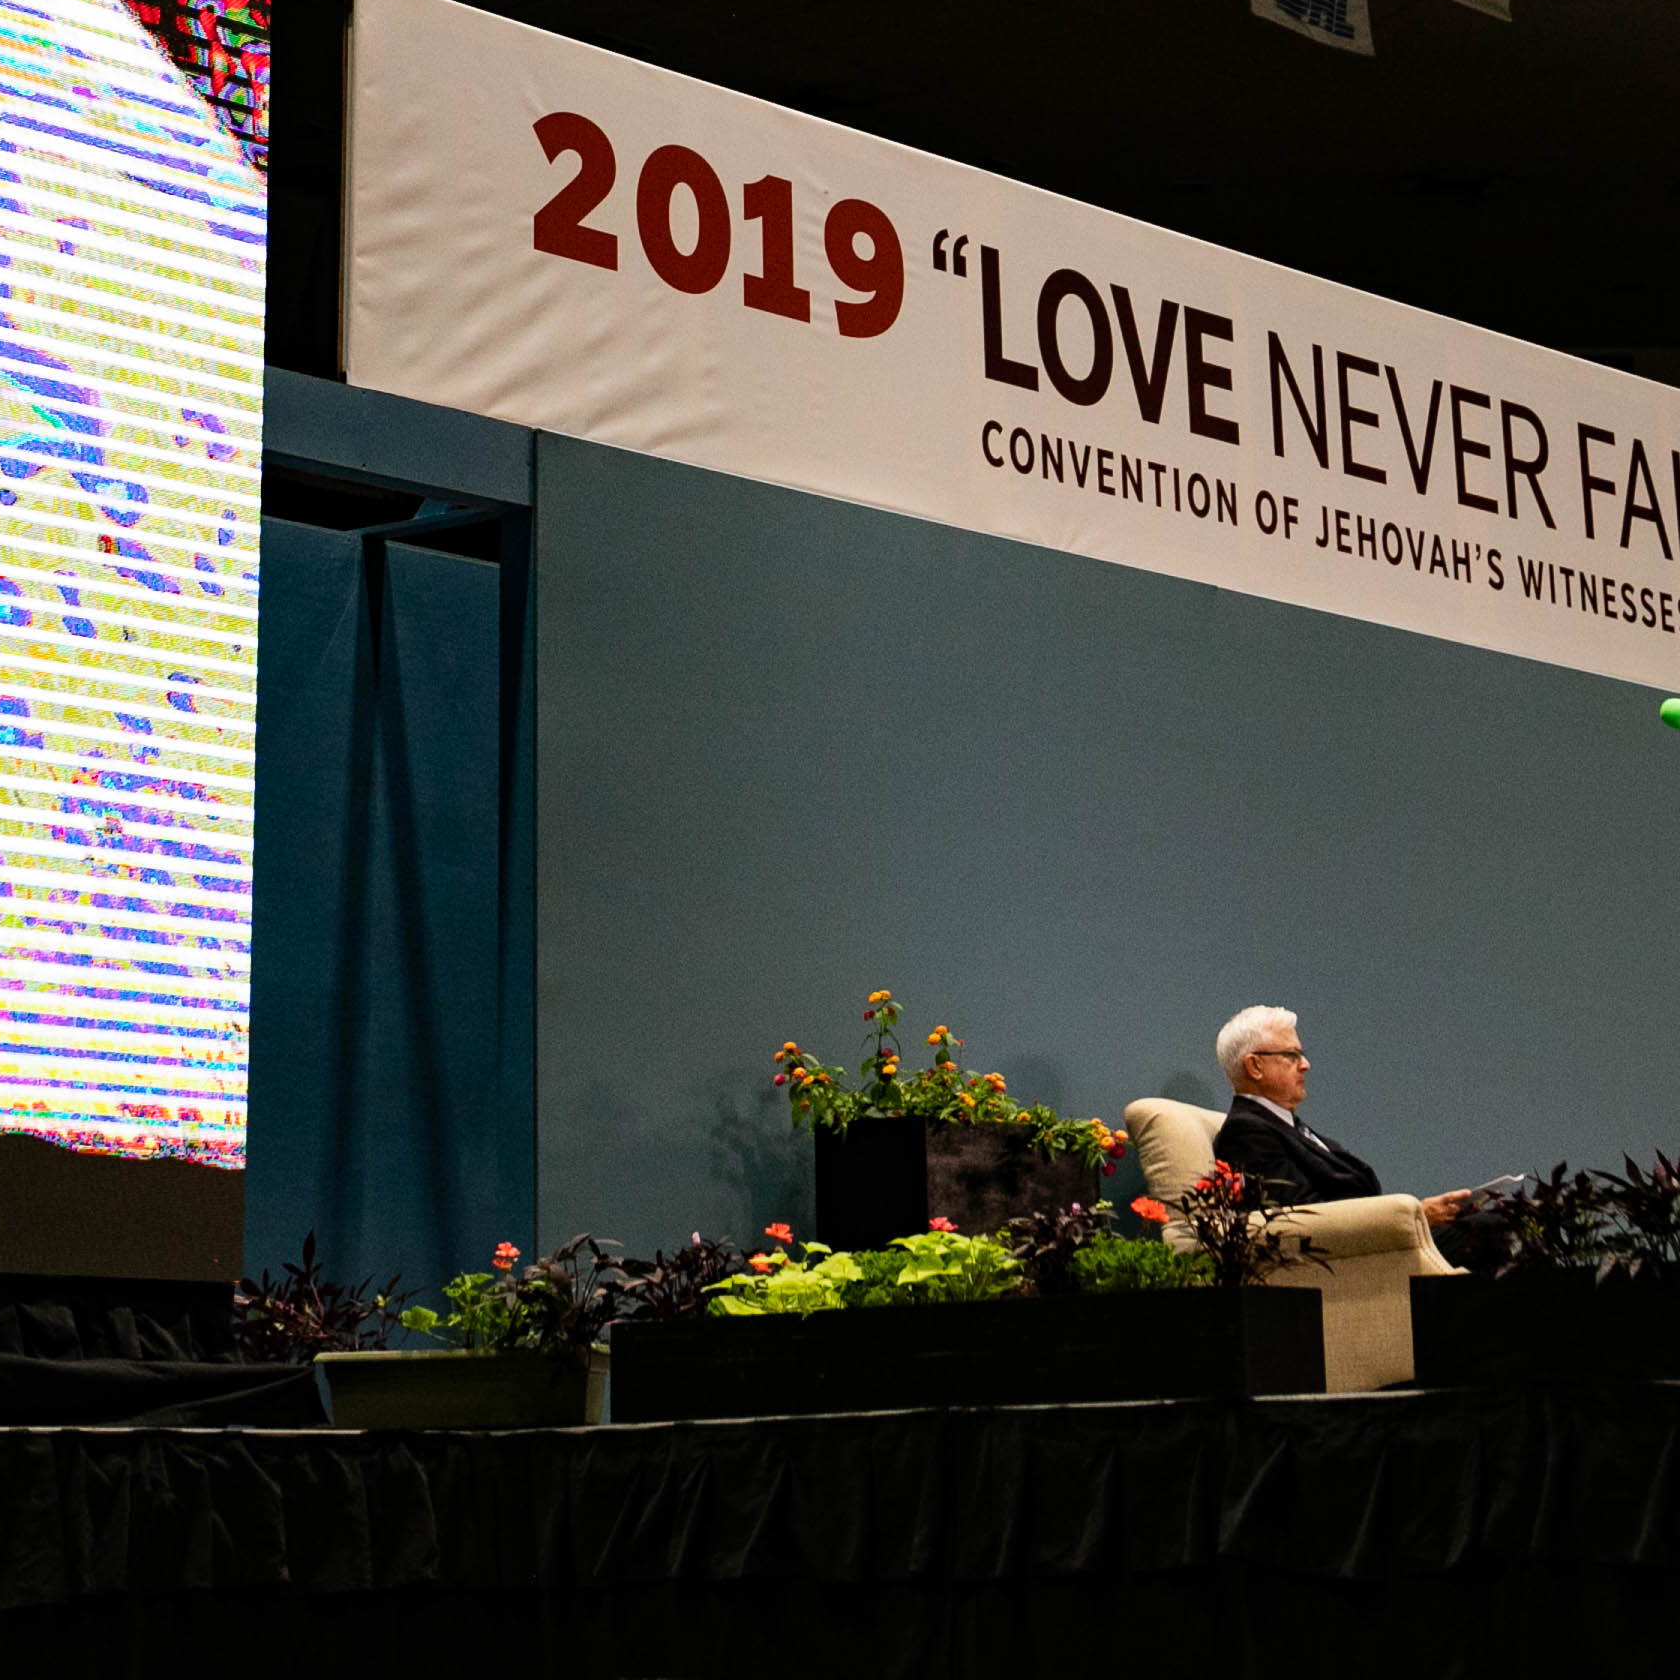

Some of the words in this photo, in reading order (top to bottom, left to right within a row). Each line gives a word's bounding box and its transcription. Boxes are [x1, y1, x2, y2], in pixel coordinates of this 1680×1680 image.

[531, 110, 905, 339] 2019
[1267, 330, 1557, 530] NEVER
[980, 420, 1239, 528] CONVENTION
[1255, 490, 1299, 541] OF
